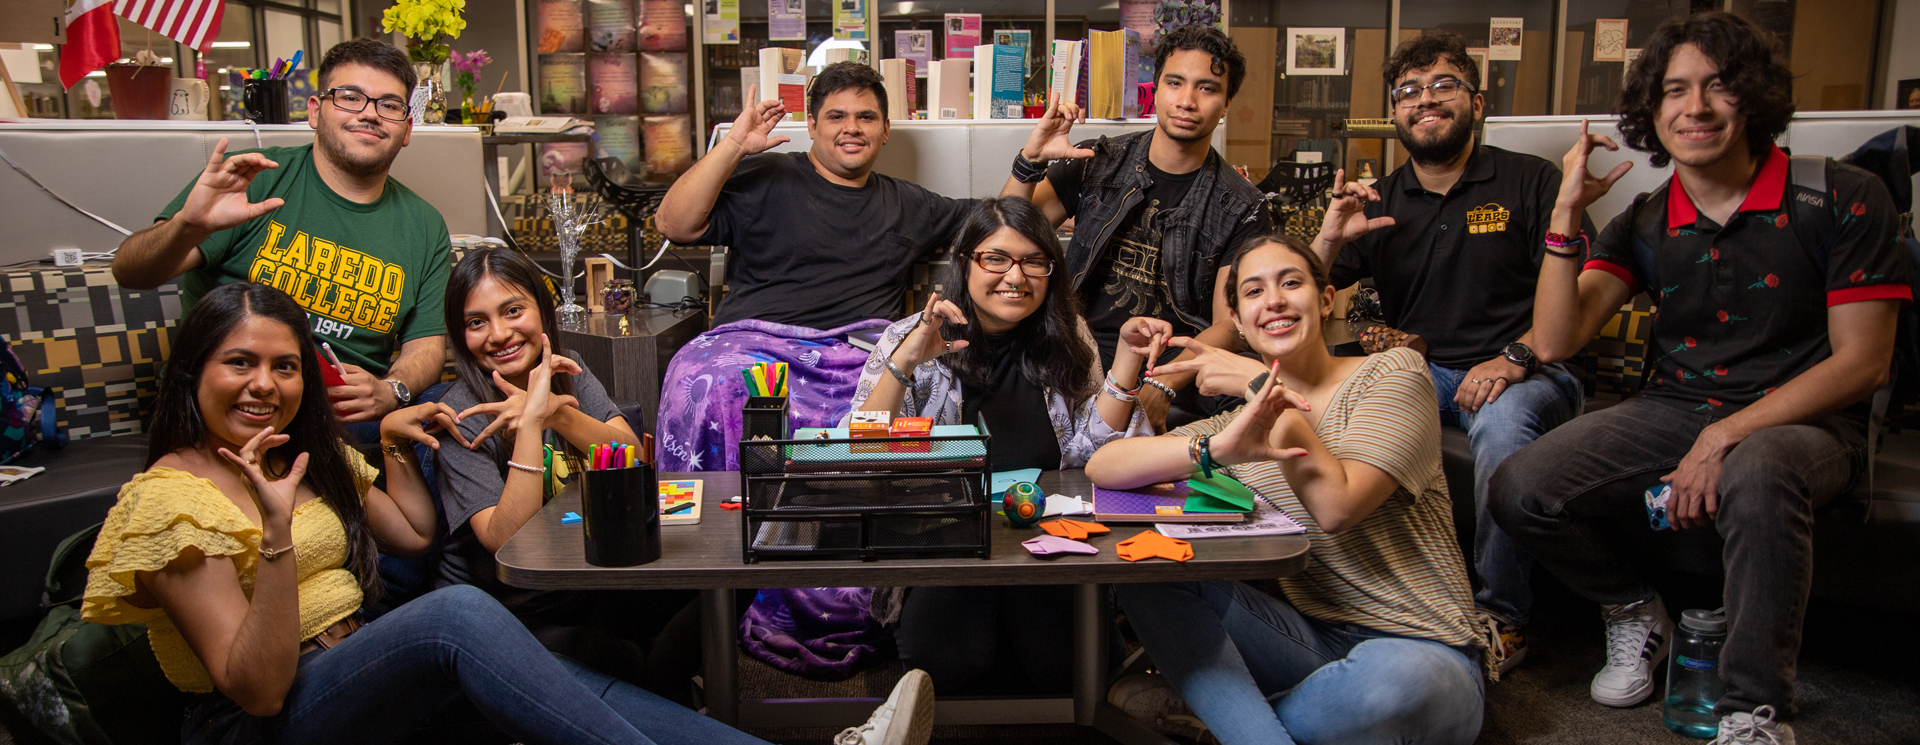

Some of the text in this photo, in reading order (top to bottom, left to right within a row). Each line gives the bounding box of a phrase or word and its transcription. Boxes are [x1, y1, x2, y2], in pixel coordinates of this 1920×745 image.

[1797, 192, 1824, 208] NASA
[1467, 210, 1510, 223] LEAPS
[256, 219, 406, 302] LAREDO
[248, 256, 401, 334] COLLEGE
[314, 317, 354, 340] 1947
[1686, 659, 1713, 668] nalgene
